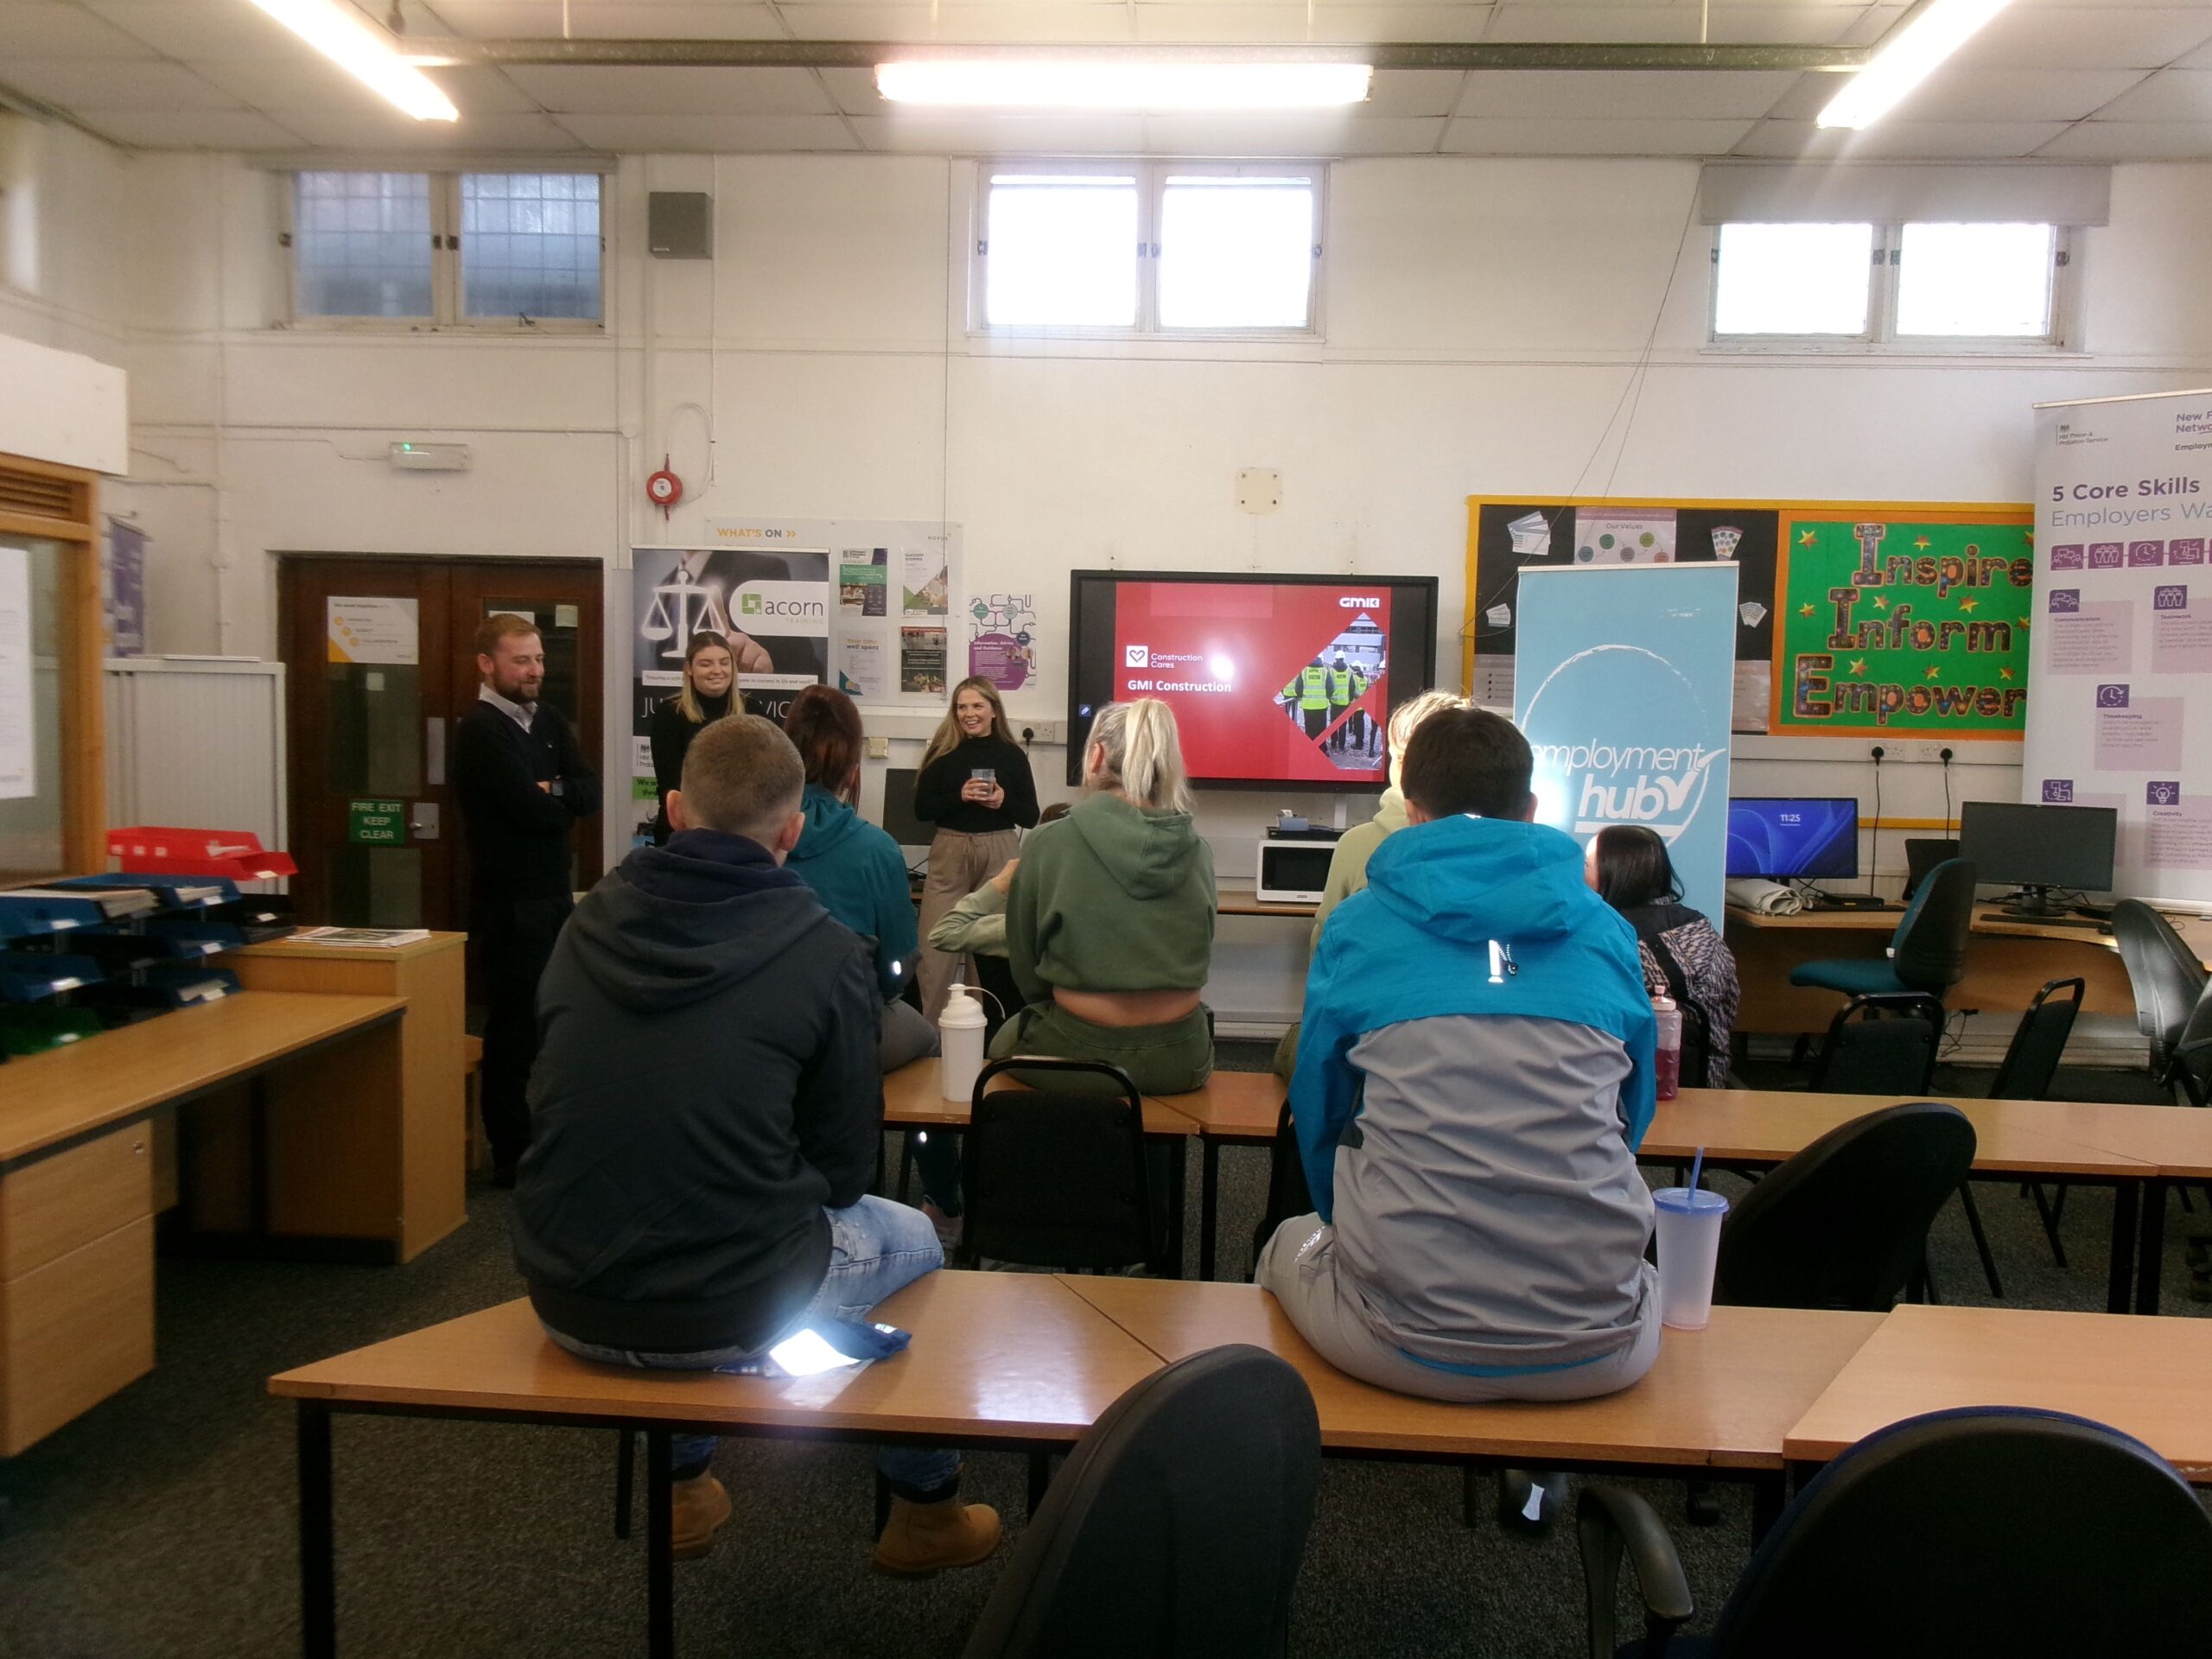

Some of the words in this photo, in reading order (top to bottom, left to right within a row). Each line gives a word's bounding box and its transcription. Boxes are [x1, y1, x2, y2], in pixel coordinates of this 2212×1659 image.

[2176, 413, 2202, 422] New
[2052, 486, 2064, 502] 5
[2073, 484, 2129, 500] Core
[2138, 477, 2200, 496] Skills
[2052, 507, 2171, 528] Employers
[717, 528, 761, 537] WHAT'S
[765, 529, 782, 537] ON
[1852, 523, 2033, 599] Inspire
[765, 601, 824, 616] acorn
[1827, 587, 2012, 652] Inform
[1128, 680, 1153, 690] GMI
[1156, 681, 1231, 692] Construction
[1793, 653, 2028, 726] Empower
[1529, 738, 1706, 777] employment
[1578, 773, 1665, 820] hub
[352, 803, 375, 812] FIRE
[378, 803, 402, 812] EXIT
[364, 817, 391, 826] KEEP
[359, 830, 394, 839] CLEAR
